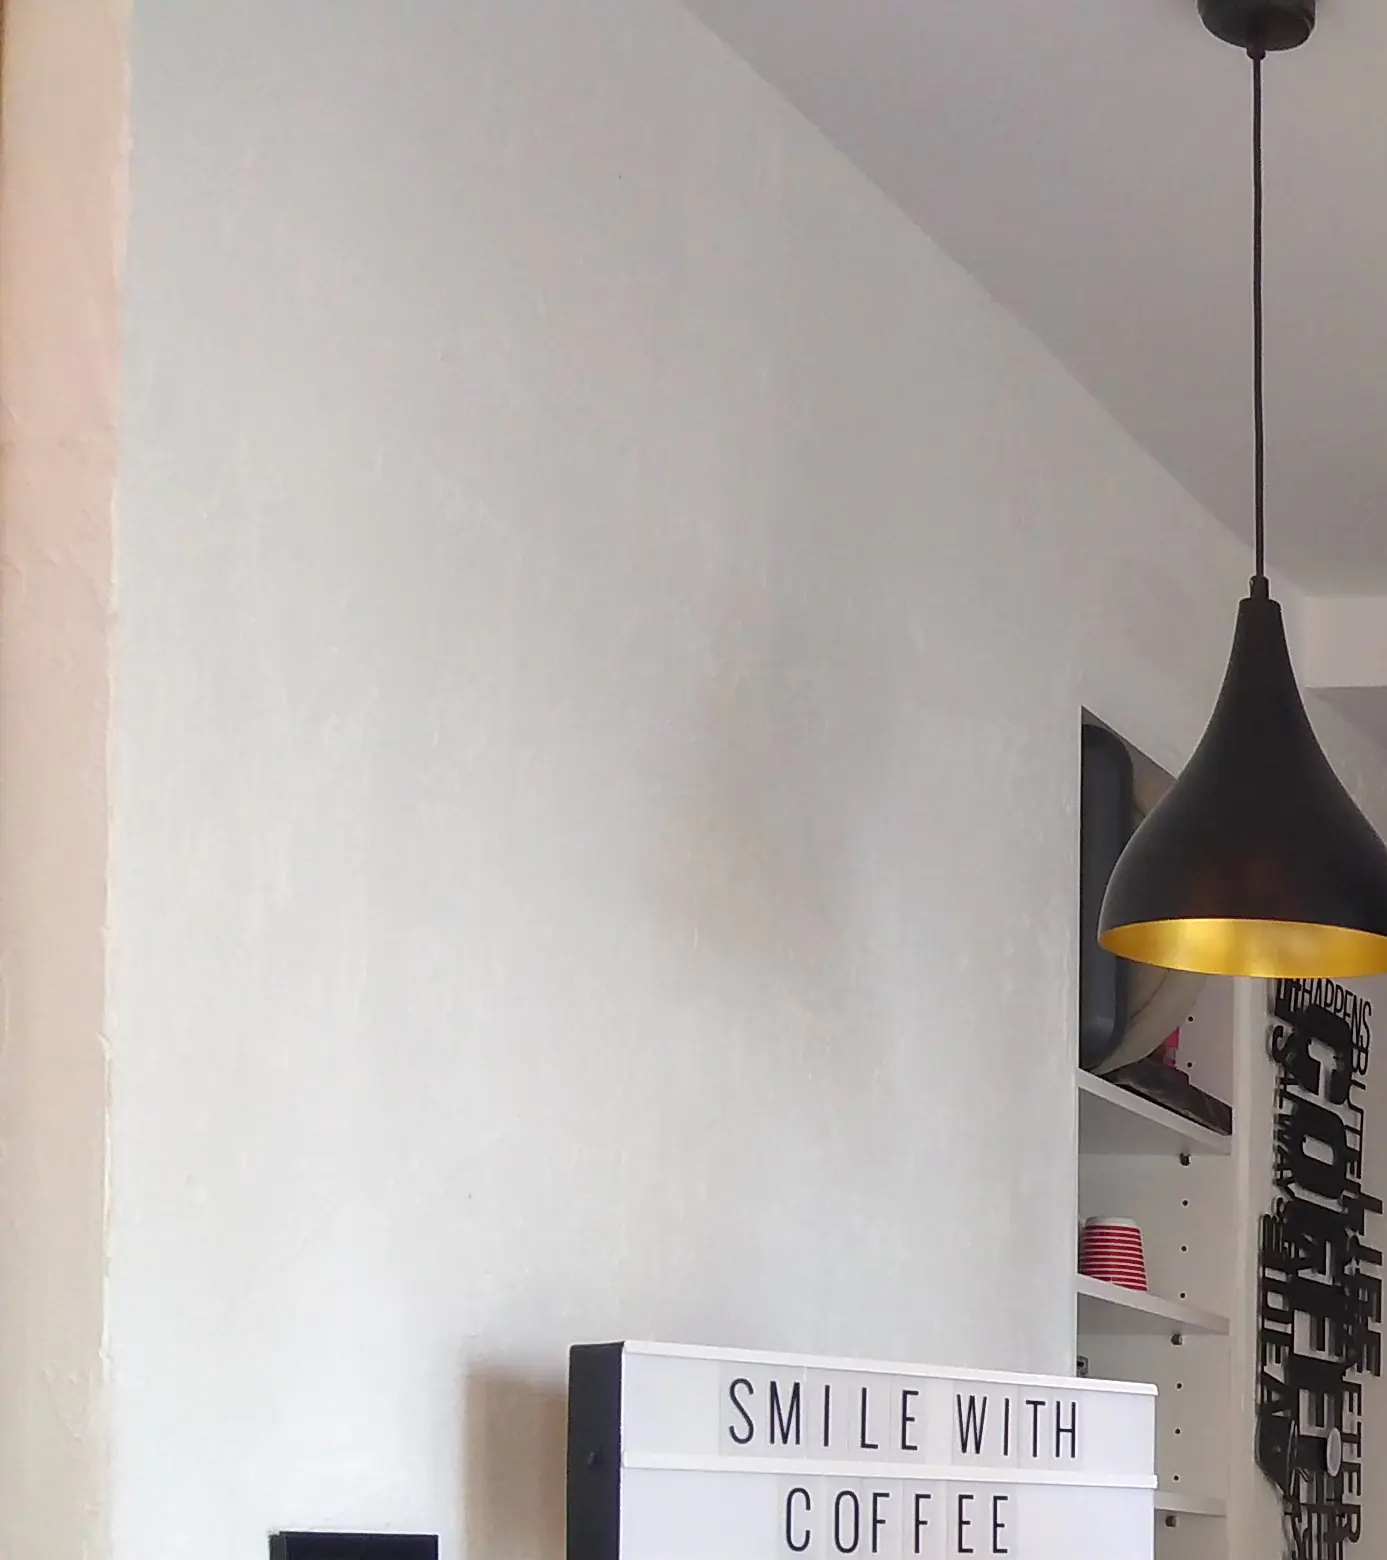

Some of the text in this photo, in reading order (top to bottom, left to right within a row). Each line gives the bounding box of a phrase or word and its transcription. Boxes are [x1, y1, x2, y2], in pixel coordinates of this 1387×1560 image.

[728, 1378, 1077, 1459] SMILE WITH
[785, 1487, 1009, 1554] COFFEE
